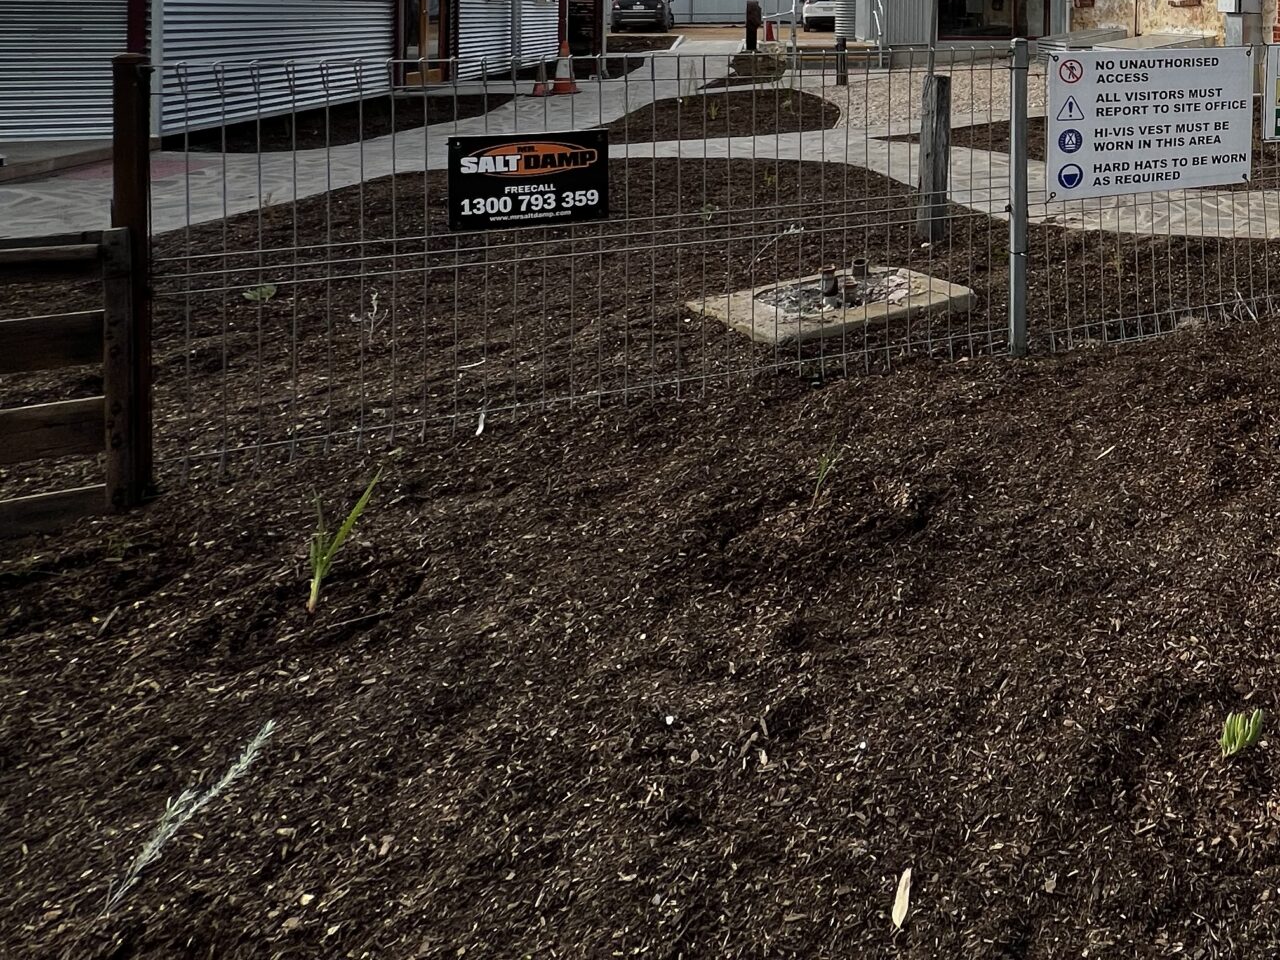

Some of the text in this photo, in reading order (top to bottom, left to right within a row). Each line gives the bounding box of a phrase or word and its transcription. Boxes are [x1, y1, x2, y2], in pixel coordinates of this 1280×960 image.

[1095, 57, 1219, 70] NO UNAUTHORISED
[1096, 73, 1149, 83] ACCESS
[1096, 88, 1222, 103] ALL VISITORS MUST
[1096, 100, 1247, 117] REPORT TO SITE OFFICE
[1094, 121, 1229, 138] HI-VIS VEST MUST BE
[1094, 135, 1221, 152] WORN IN THIS AREA
[460, 150, 597, 174] SALT DAMP
[1093, 153, 1247, 173] HARD HATS TO BE WORN
[1093, 171, 1181, 186] AS REQUIRED
[504, 183, 556, 194] FREECALL
[461, 189, 599, 216] 1300 793 359
[489, 209, 572, 222] www.mrsaltdamp.com
